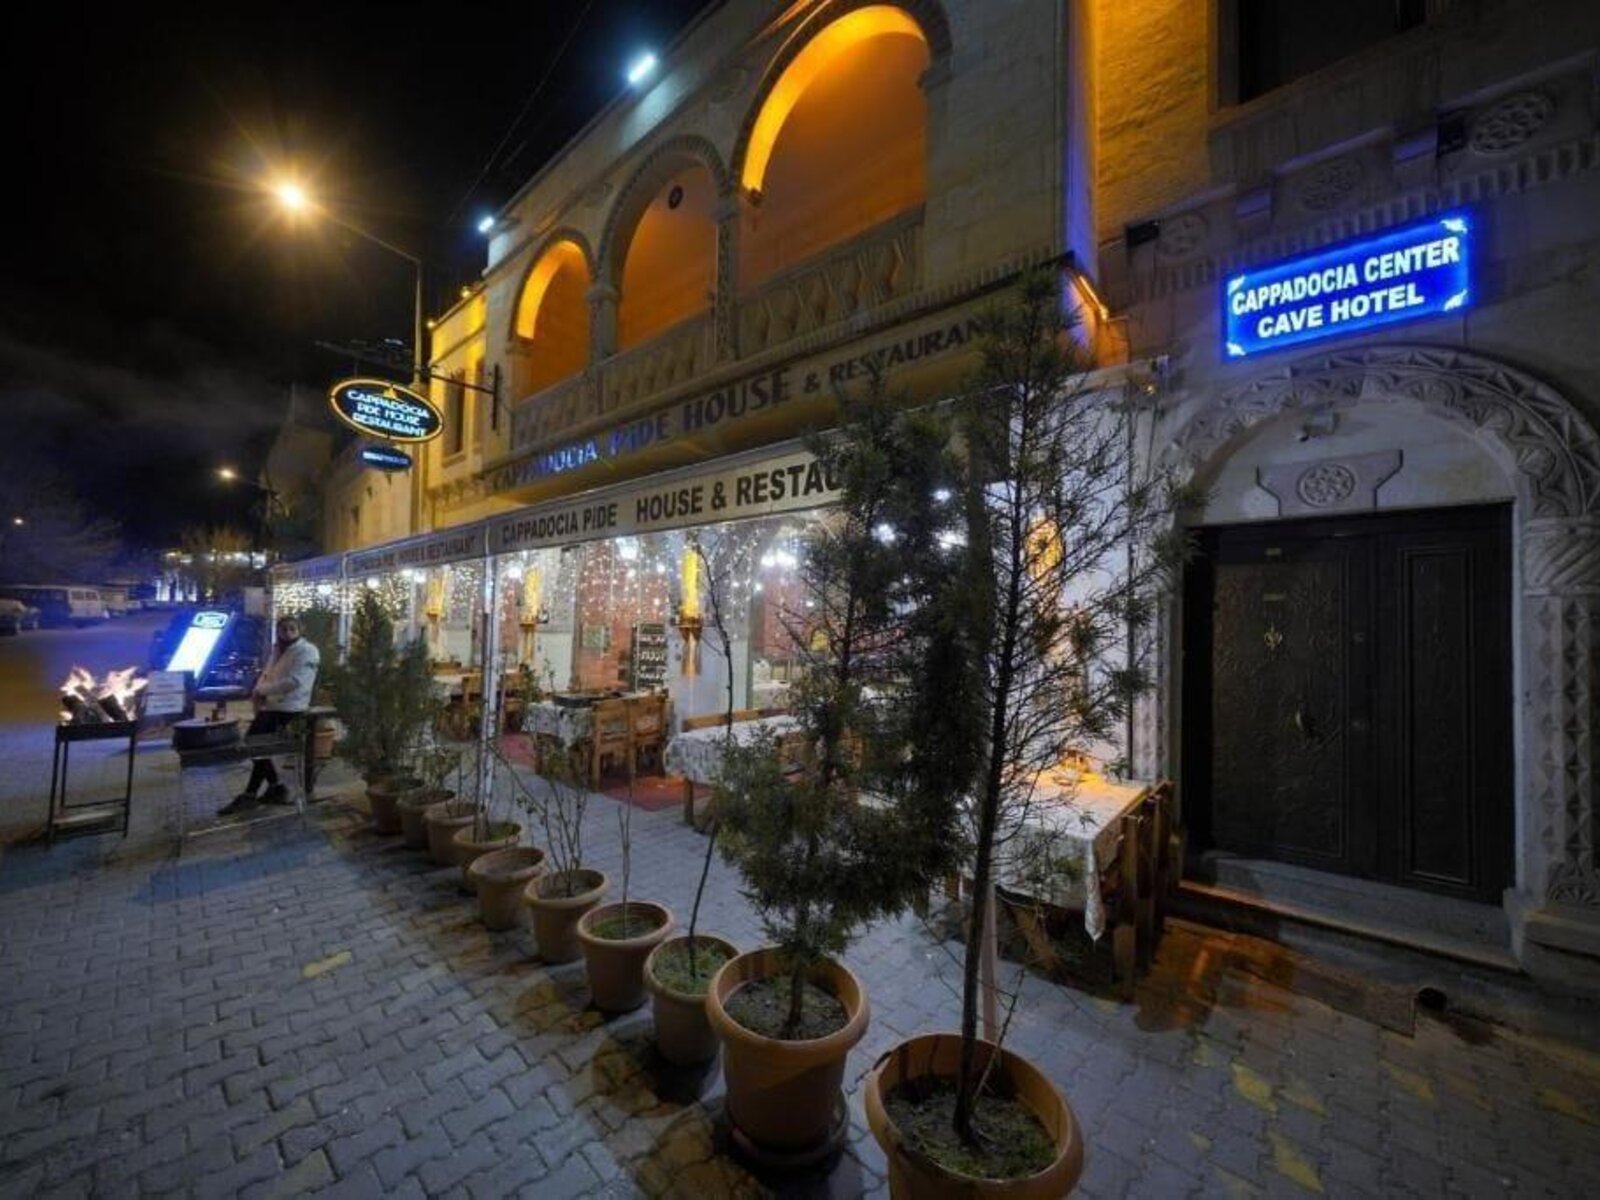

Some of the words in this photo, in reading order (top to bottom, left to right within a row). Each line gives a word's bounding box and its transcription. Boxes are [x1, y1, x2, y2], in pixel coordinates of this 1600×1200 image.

[1232, 263, 1359, 315] CAPPADOCIA
[1363, 236, 1461, 283] CENTER
[1257, 303, 1324, 338] CAVE
[1330, 282, 1425, 323] HOTEL
[682, 368, 791, 431] HOUSE
[804, 372, 820, 393] &
[502, 511, 579, 545] CAPPADOCIA
[583, 503, 619, 532] PIDE
[635, 485, 704, 524] HOUSE
[712, 481, 727, 511] &
